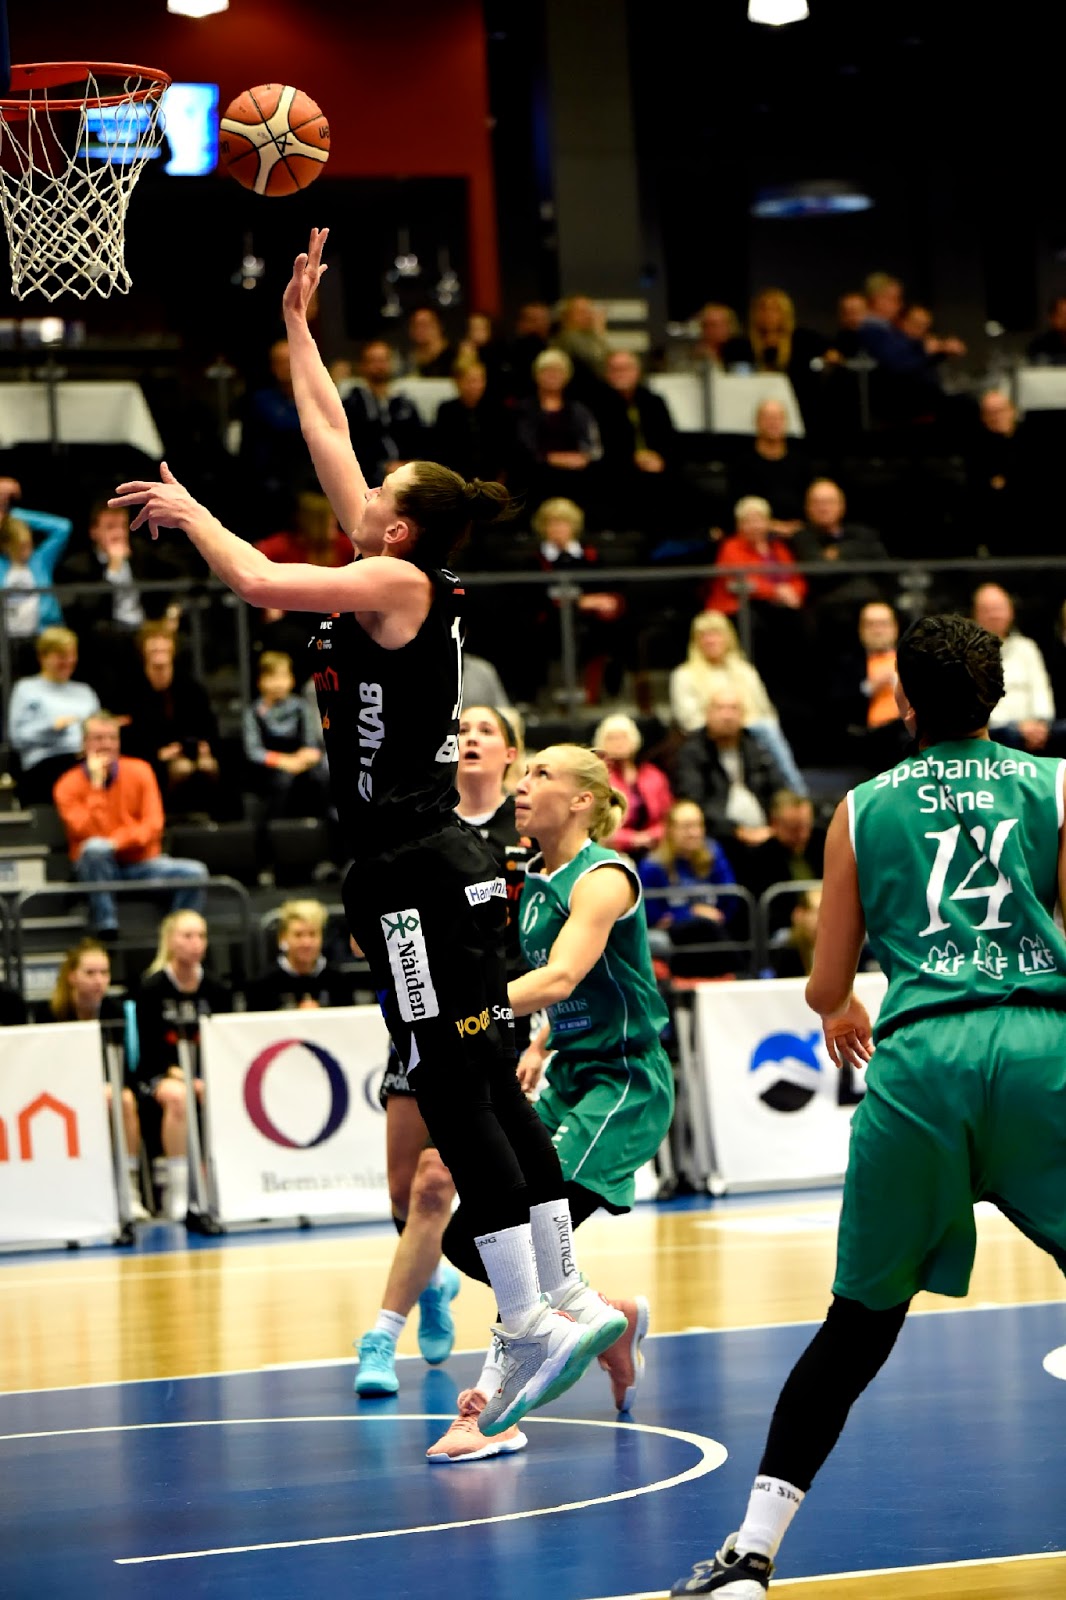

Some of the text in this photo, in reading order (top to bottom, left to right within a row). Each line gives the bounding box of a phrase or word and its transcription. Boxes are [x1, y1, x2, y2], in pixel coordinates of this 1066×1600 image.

[357, 681, 386, 768] LKAB
[918, 818, 1020, 937] 14
[522, 890, 546, 935] 6
[972, 949, 1009, 974] LKF
[1018, 949, 1055, 973] LKF
[492, 1004, 515, 1020] Sca
[553, 1214, 577, 1278] SPALDING
